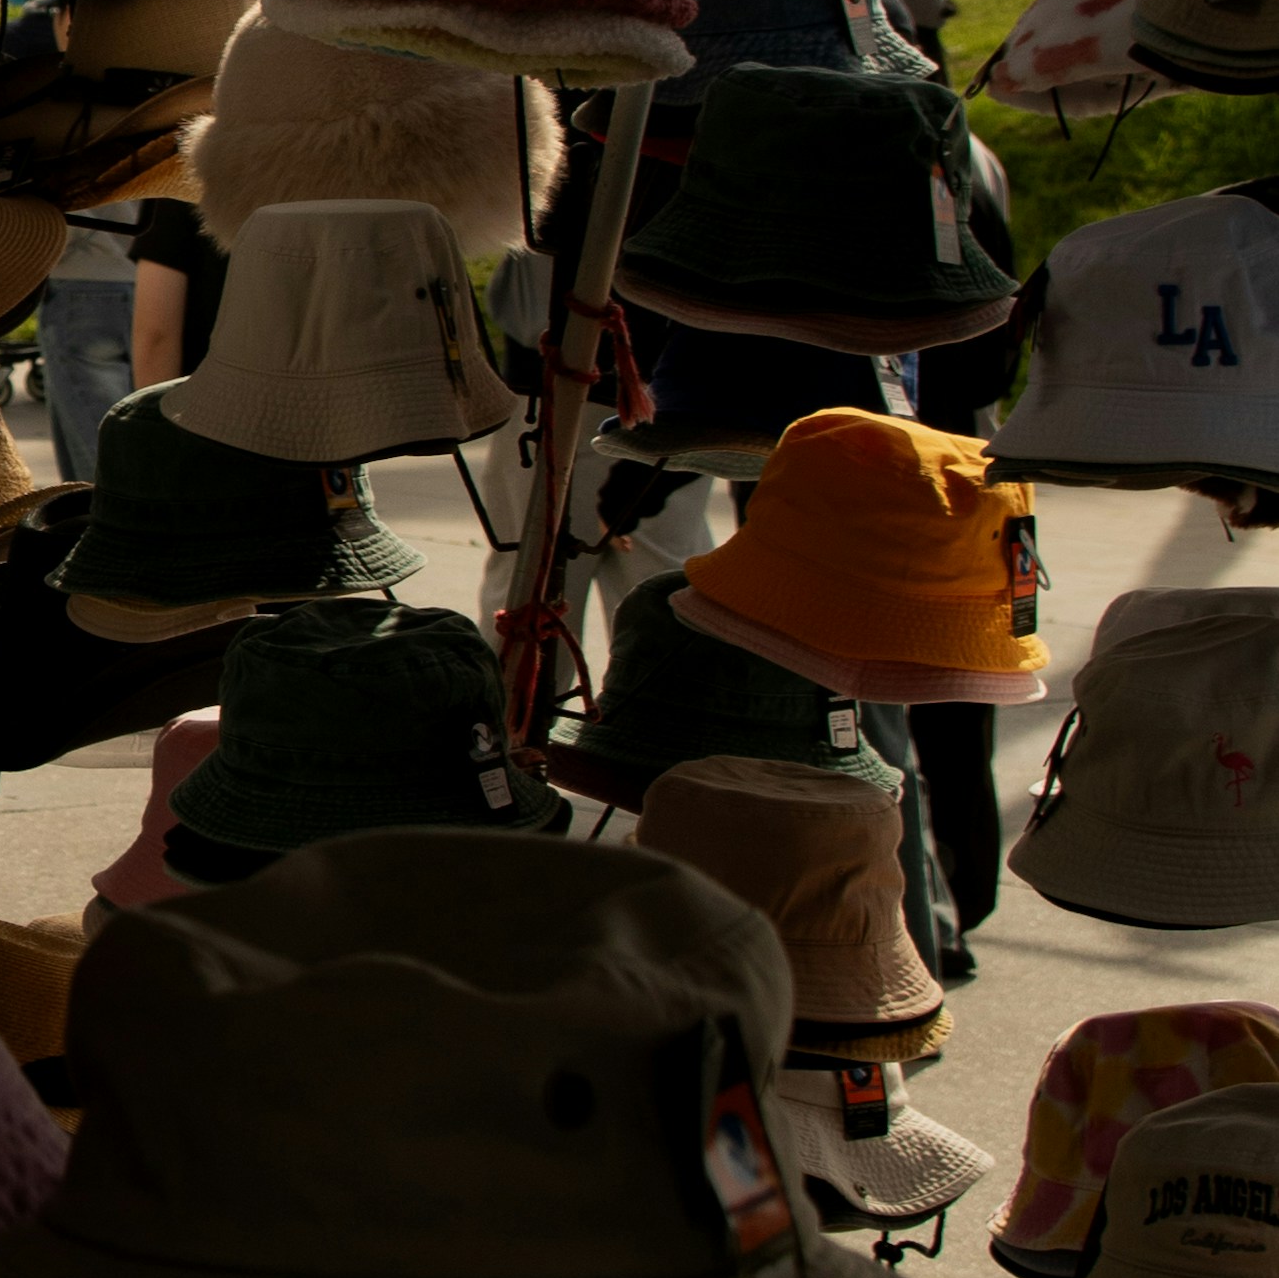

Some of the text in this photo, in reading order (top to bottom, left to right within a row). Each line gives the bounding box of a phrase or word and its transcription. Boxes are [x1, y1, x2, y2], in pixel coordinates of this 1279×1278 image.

[1157, 284, 1239, 367] LA
[1143, 1177, 1189, 1225] LOS
[1180, 1228, 1266, 1255] California
